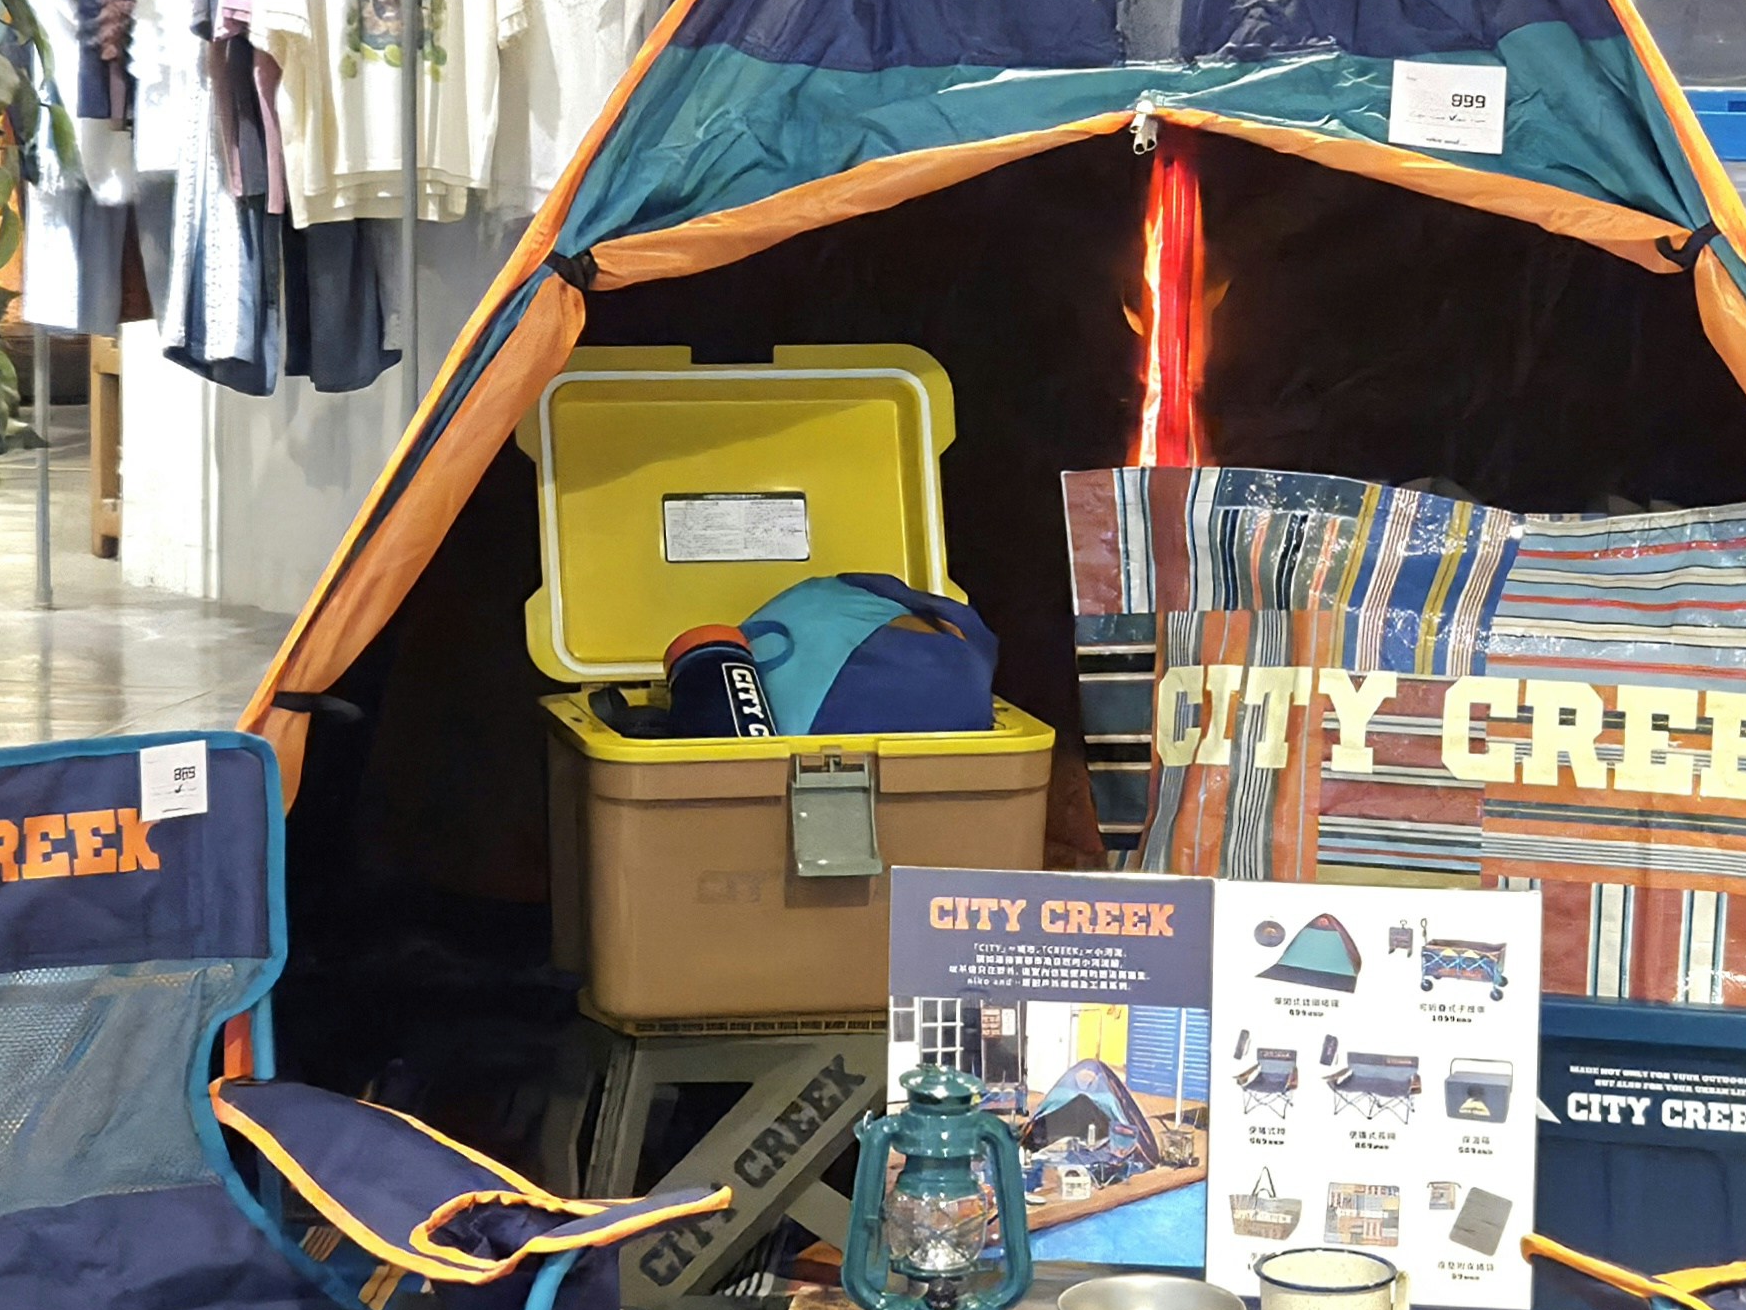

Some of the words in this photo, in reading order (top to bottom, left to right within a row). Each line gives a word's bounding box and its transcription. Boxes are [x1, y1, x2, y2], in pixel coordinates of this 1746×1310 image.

[732, 668, 764, 719] CITY
[1156, 663, 1397, 775] CITY
[929, 896, 1027, 932] CITY
[1041, 900, 1175, 937] CREEK
[734, 1053, 866, 1188] CREEK
[1567, 1092, 1651, 1126] CITY
